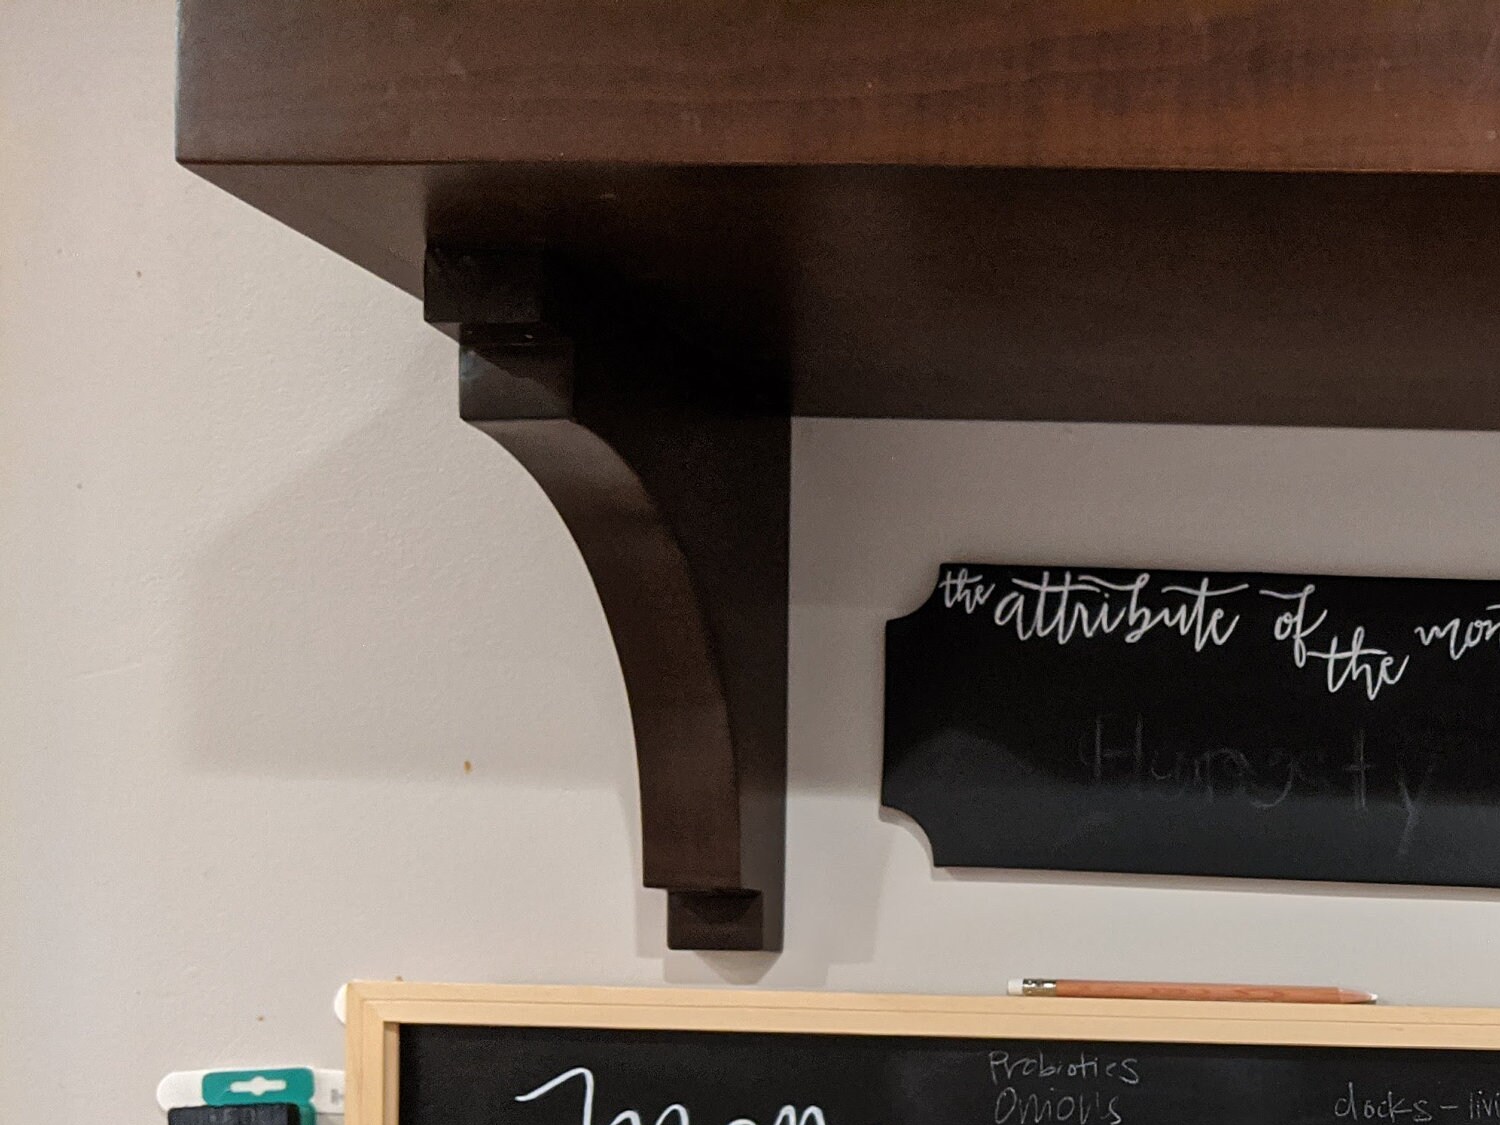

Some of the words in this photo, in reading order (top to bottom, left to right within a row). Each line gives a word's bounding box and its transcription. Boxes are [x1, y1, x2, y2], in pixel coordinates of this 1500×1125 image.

[940, 569, 995, 613] the
[994, 572, 1252, 652] attribute
[1259, 584, 1327, 667] of
[1307, 627, 1411, 700] the
[989, 1050, 1139, 1085] Probiotics
